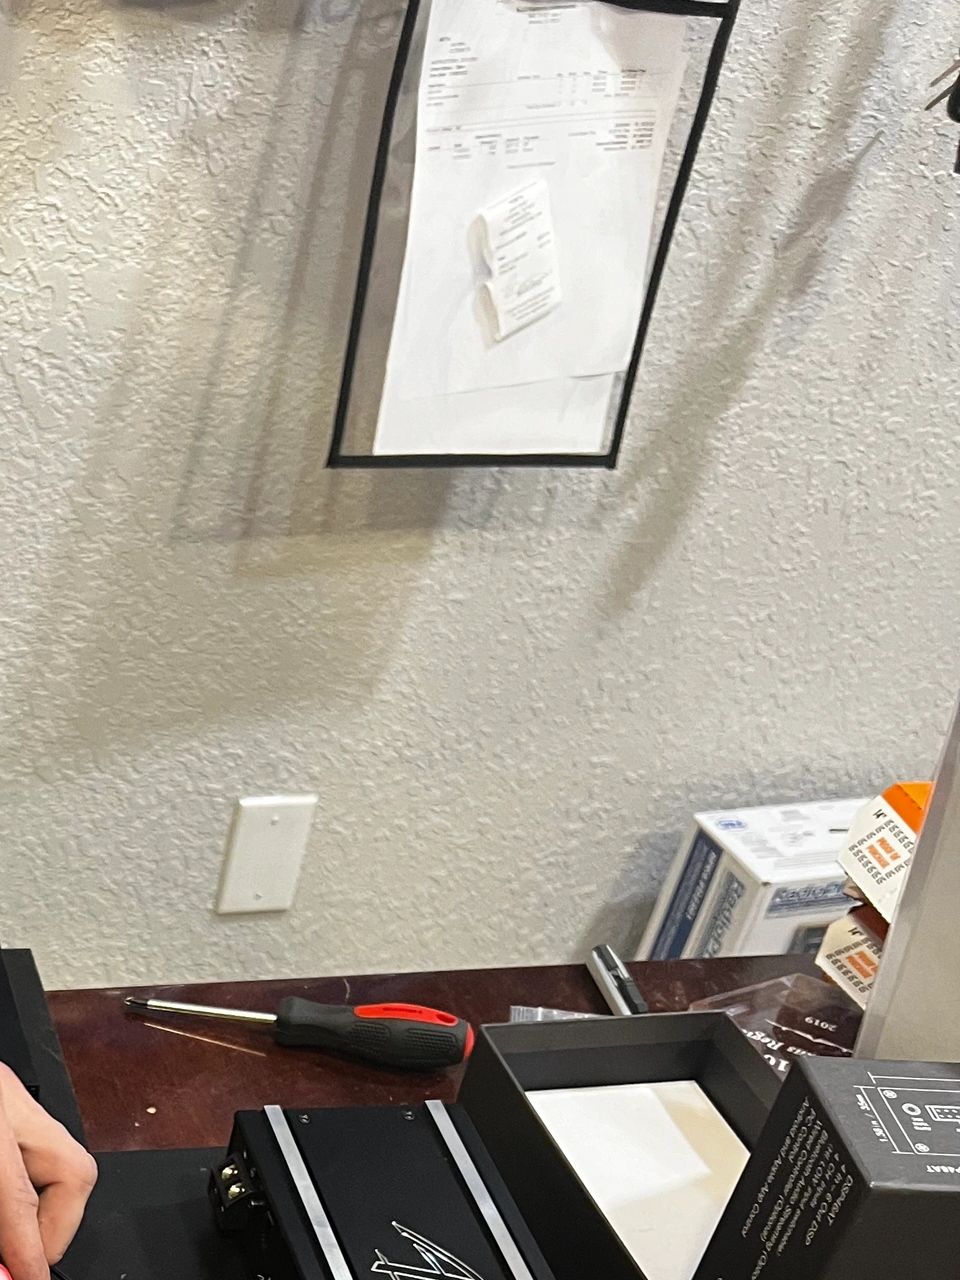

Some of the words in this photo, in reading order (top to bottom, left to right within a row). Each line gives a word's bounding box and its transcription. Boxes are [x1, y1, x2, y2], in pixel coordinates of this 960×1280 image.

[804, 1016, 838, 1032] 2019
[742, 1028, 785, 1051] Regi
[805, 1220, 819, 1246] DSP
